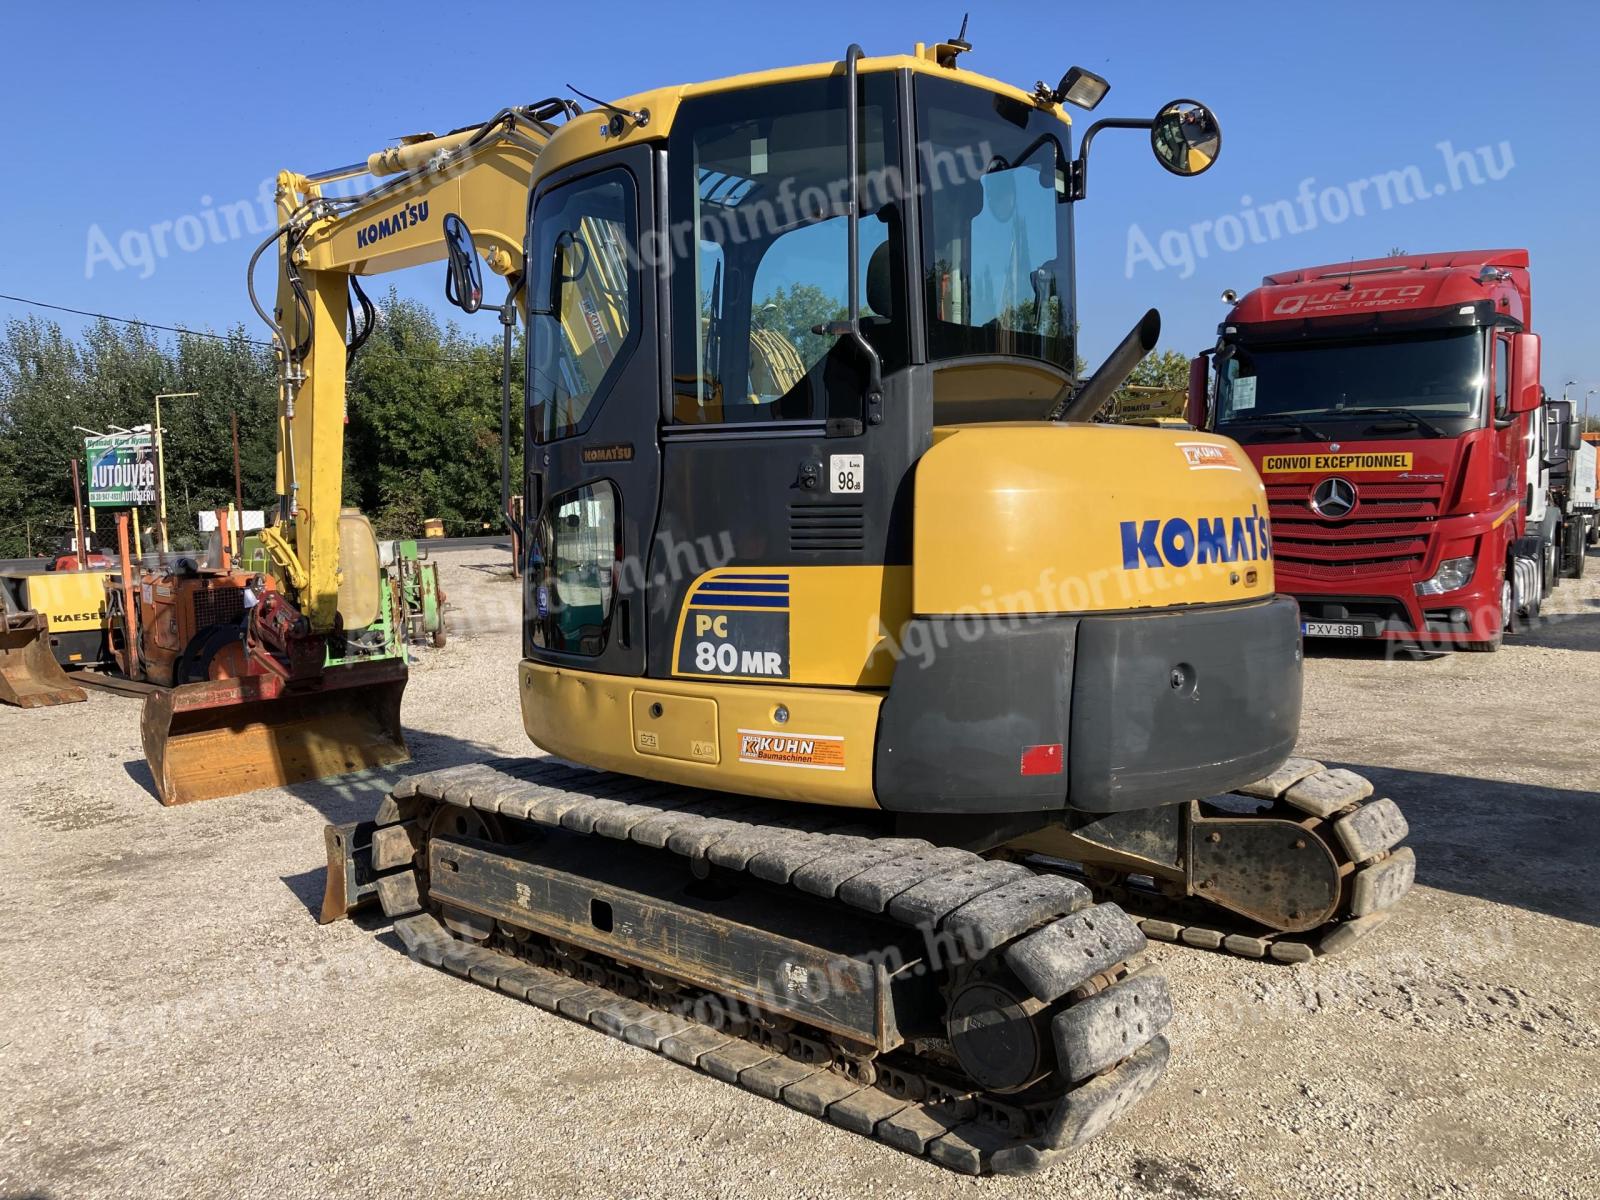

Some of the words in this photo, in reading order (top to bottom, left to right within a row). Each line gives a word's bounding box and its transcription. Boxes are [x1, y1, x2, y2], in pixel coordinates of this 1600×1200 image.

[356, 200, 429, 249] KOMATSU
[584, 446, 632, 461] KOMATSU
[1267, 457, 1311, 469] CONVOI
[1315, 455, 1408, 468] EXCEPTIONNEL
[838, 471, 854, 490] 98
[53, 612, 106, 623] KAESER
[696, 614, 728, 638] PC
[760, 737, 815, 755] KUHN
[758, 751, 812, 763] Baumaschinen
